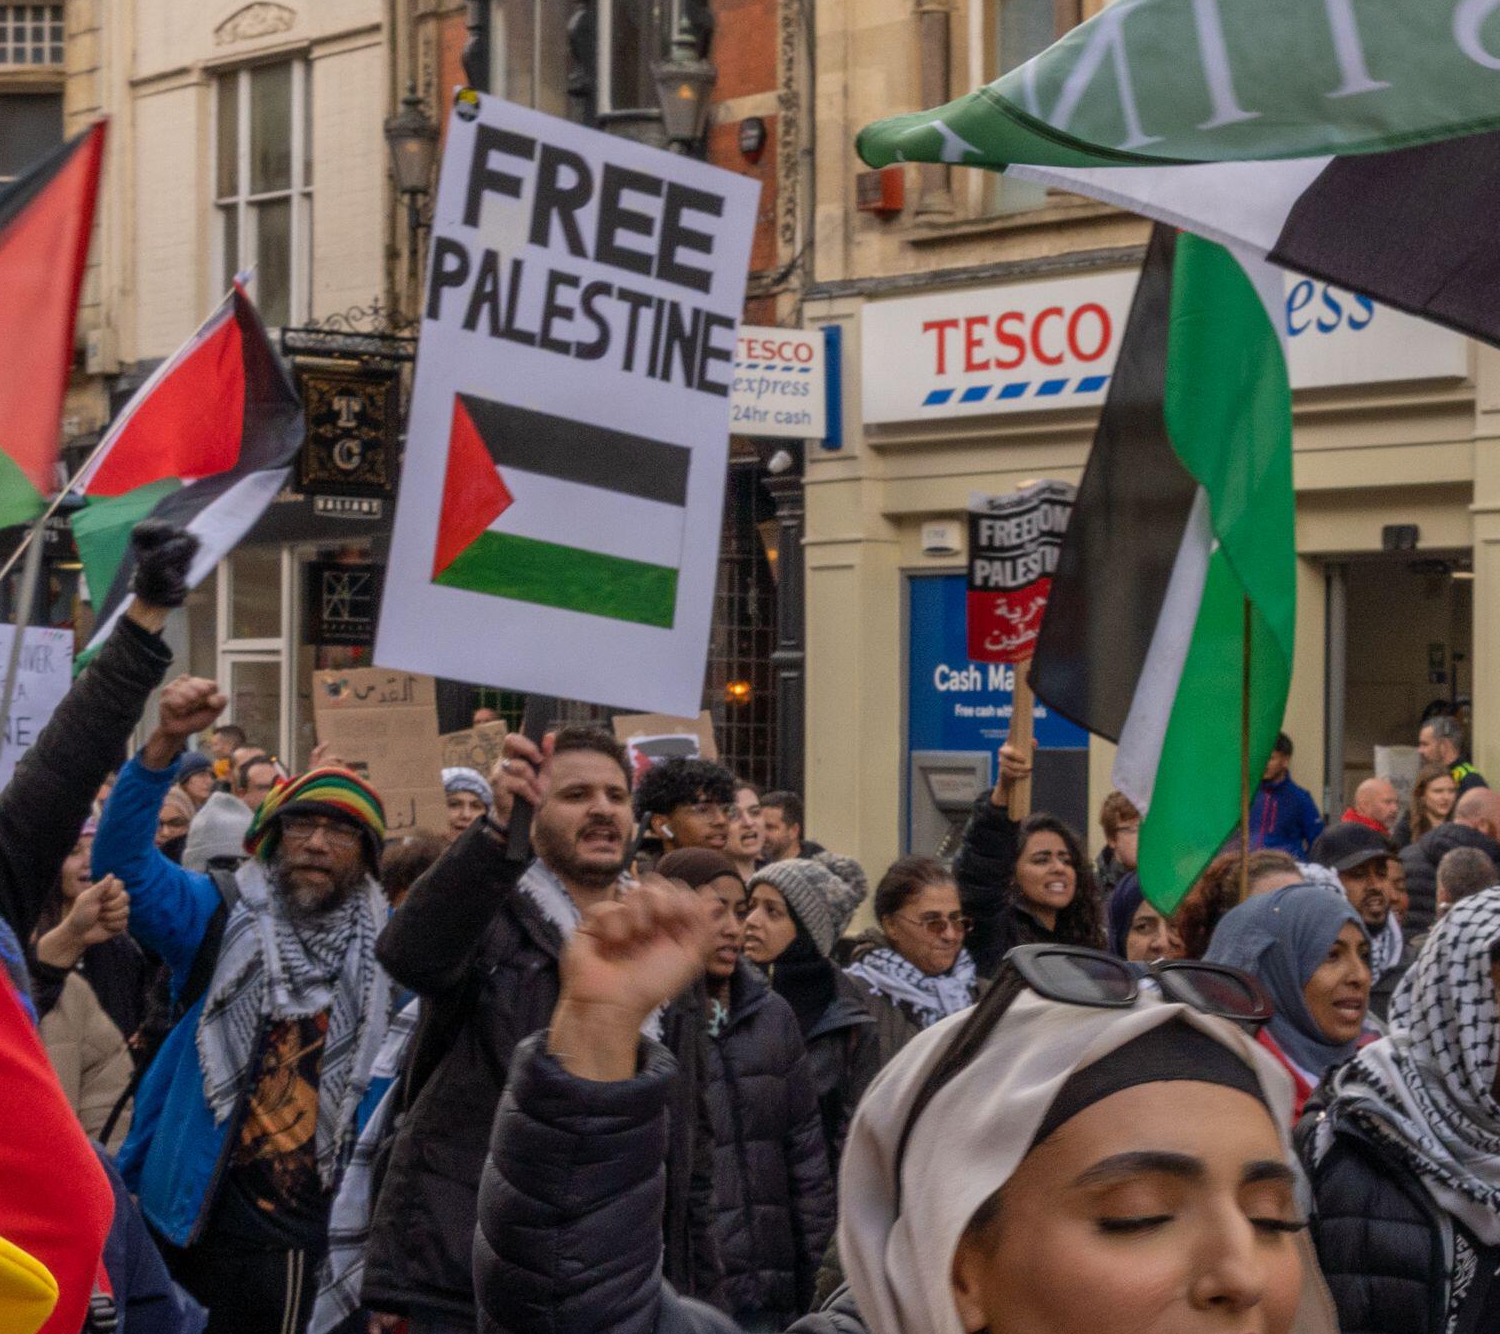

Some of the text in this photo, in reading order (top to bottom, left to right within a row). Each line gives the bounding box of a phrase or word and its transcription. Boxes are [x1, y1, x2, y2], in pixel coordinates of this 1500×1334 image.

[461, 122, 726, 295] FREE
[426, 235, 737, 399] PALESTINE
[922, 303, 1113, 375] TESCO
[732, 377, 811, 399] express
[733, 404, 811, 425] 24hr cash
[979, 504, 1074, 547] FREEOM
[18, 645, 55, 674] IVER
[934, 664, 1015, 692] Cash Ma
[955, 705, 974, 717] Free
[975, 705, 996, 718] cash
